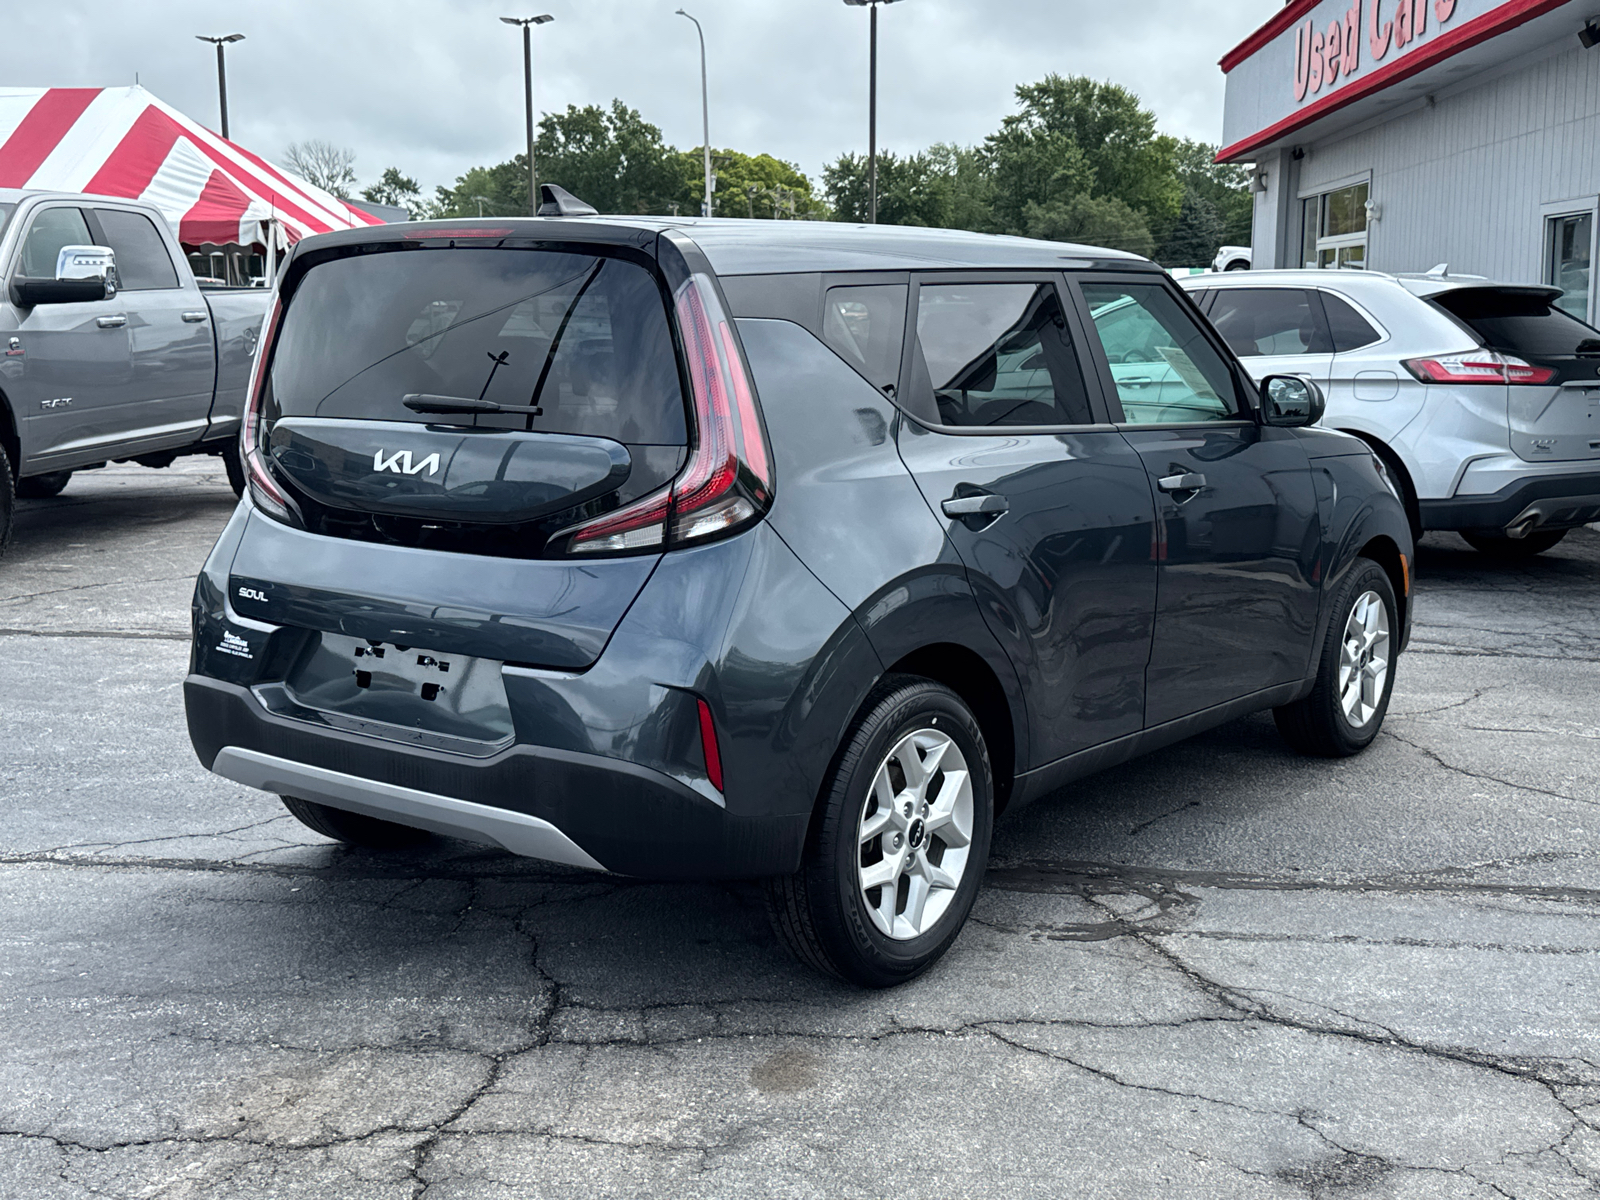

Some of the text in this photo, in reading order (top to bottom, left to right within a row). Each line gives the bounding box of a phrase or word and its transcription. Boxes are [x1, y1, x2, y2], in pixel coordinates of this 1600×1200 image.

[1293, 0, 1458, 102] Used Ca
[373, 448, 440, 477] KIA
[238, 586, 269, 602] SOUL
